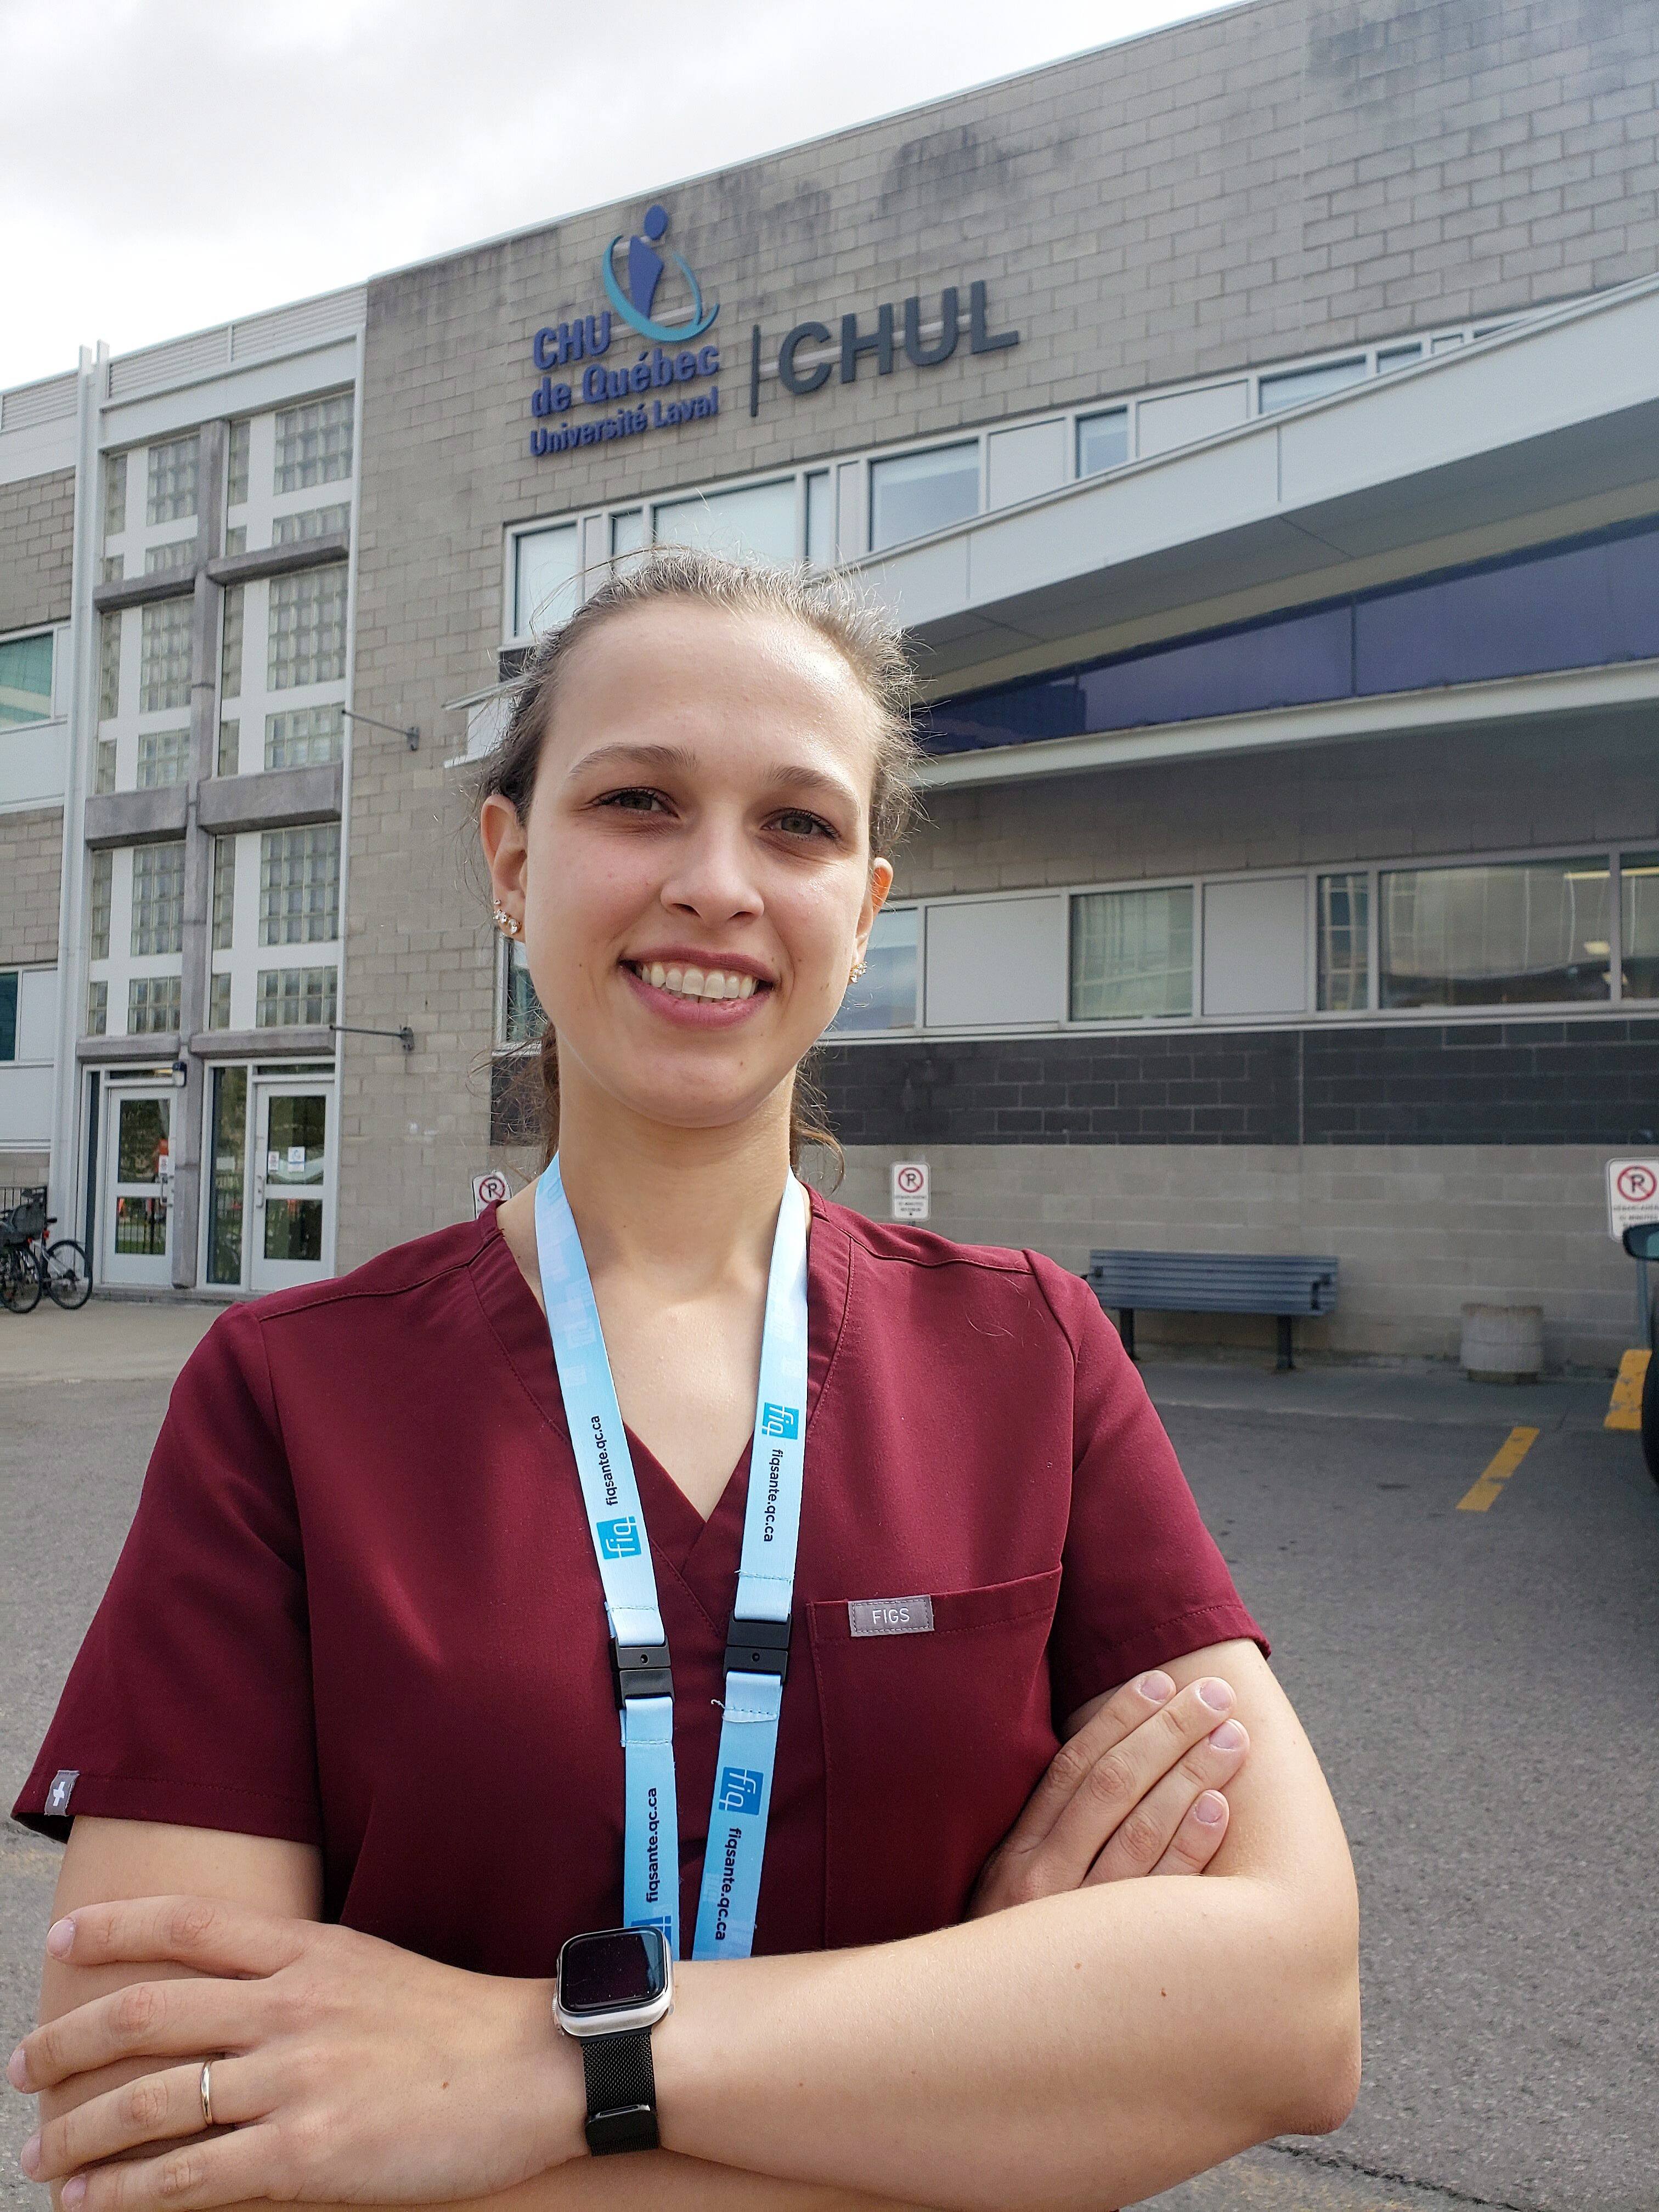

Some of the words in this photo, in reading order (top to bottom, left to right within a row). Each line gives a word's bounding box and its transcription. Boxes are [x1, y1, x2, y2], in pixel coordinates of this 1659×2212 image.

[531, 376, 572, 418] de
[582, 344, 720, 404] Québec
[533, 310, 611, 371] CHU
[778, 279, 1020, 395] CHUL
[529, 403, 648, 456] Université
[653, 385, 719, 428] Laval
[591, 1415, 618, 1506] fiqsante.qc.ca
[764, 1449, 783, 1542] fiqsante.qc.ca
[872, 1607, 910, 1625] FIGS
[646, 1787, 661, 1903] fiqsante.qc.ca
[715, 1827, 742, 1941] fiqsante.qc.ca
